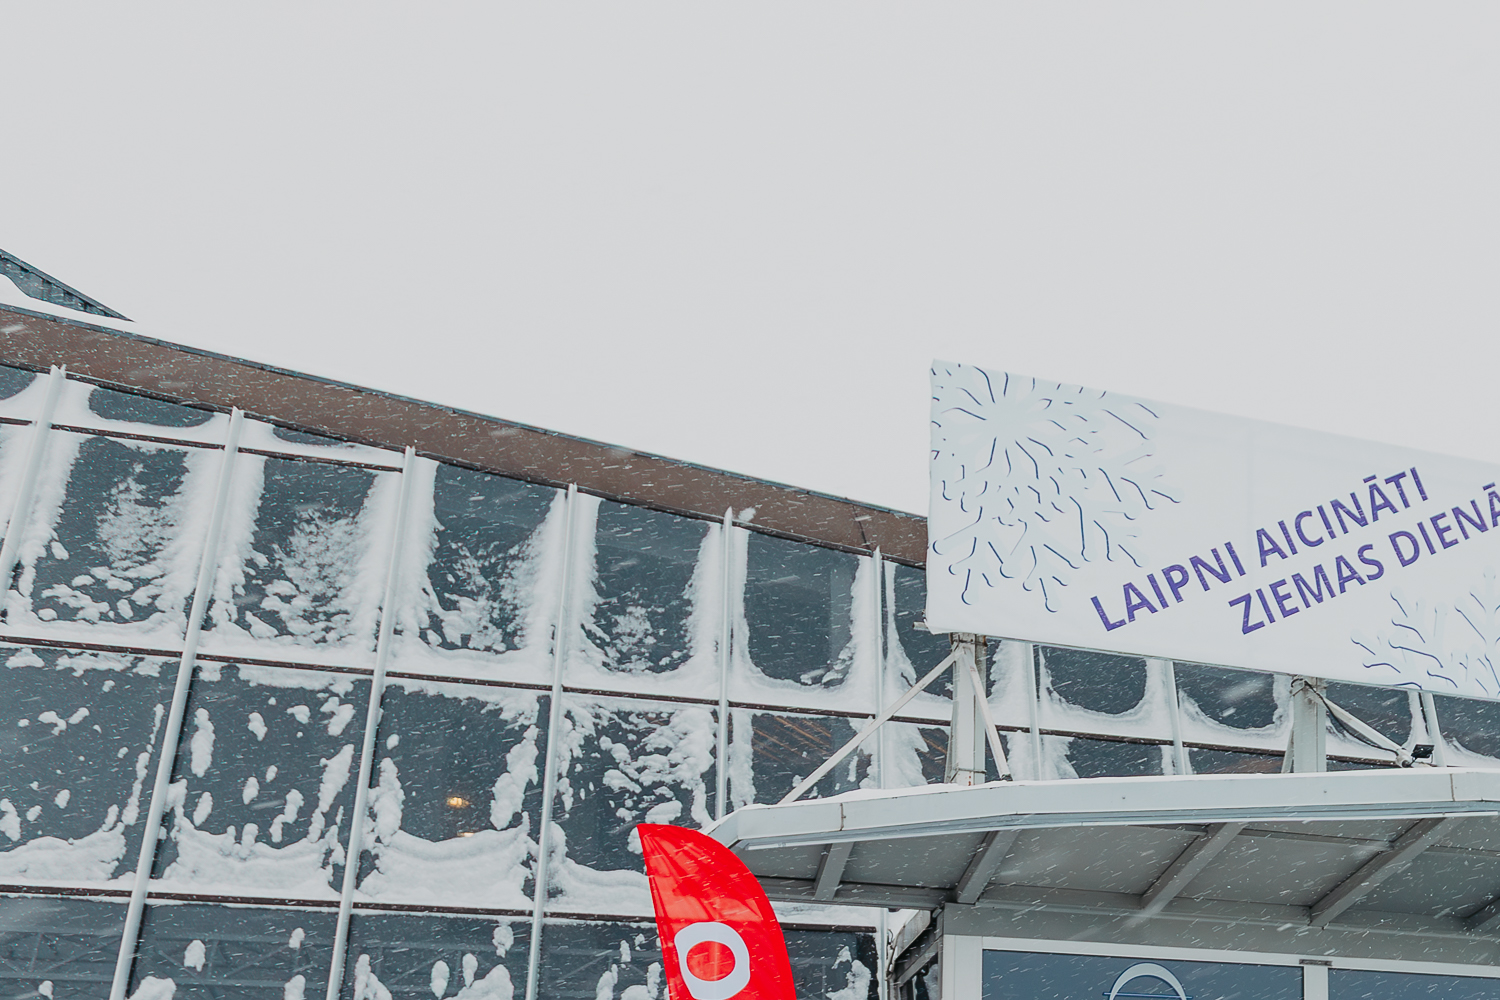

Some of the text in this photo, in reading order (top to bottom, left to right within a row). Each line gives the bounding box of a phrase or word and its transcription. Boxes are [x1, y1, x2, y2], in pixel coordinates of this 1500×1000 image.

[1091, 468, 1429, 632] LAIPNI AICINĀTI
[1229, 544, 1385, 634] ZIEMAS
